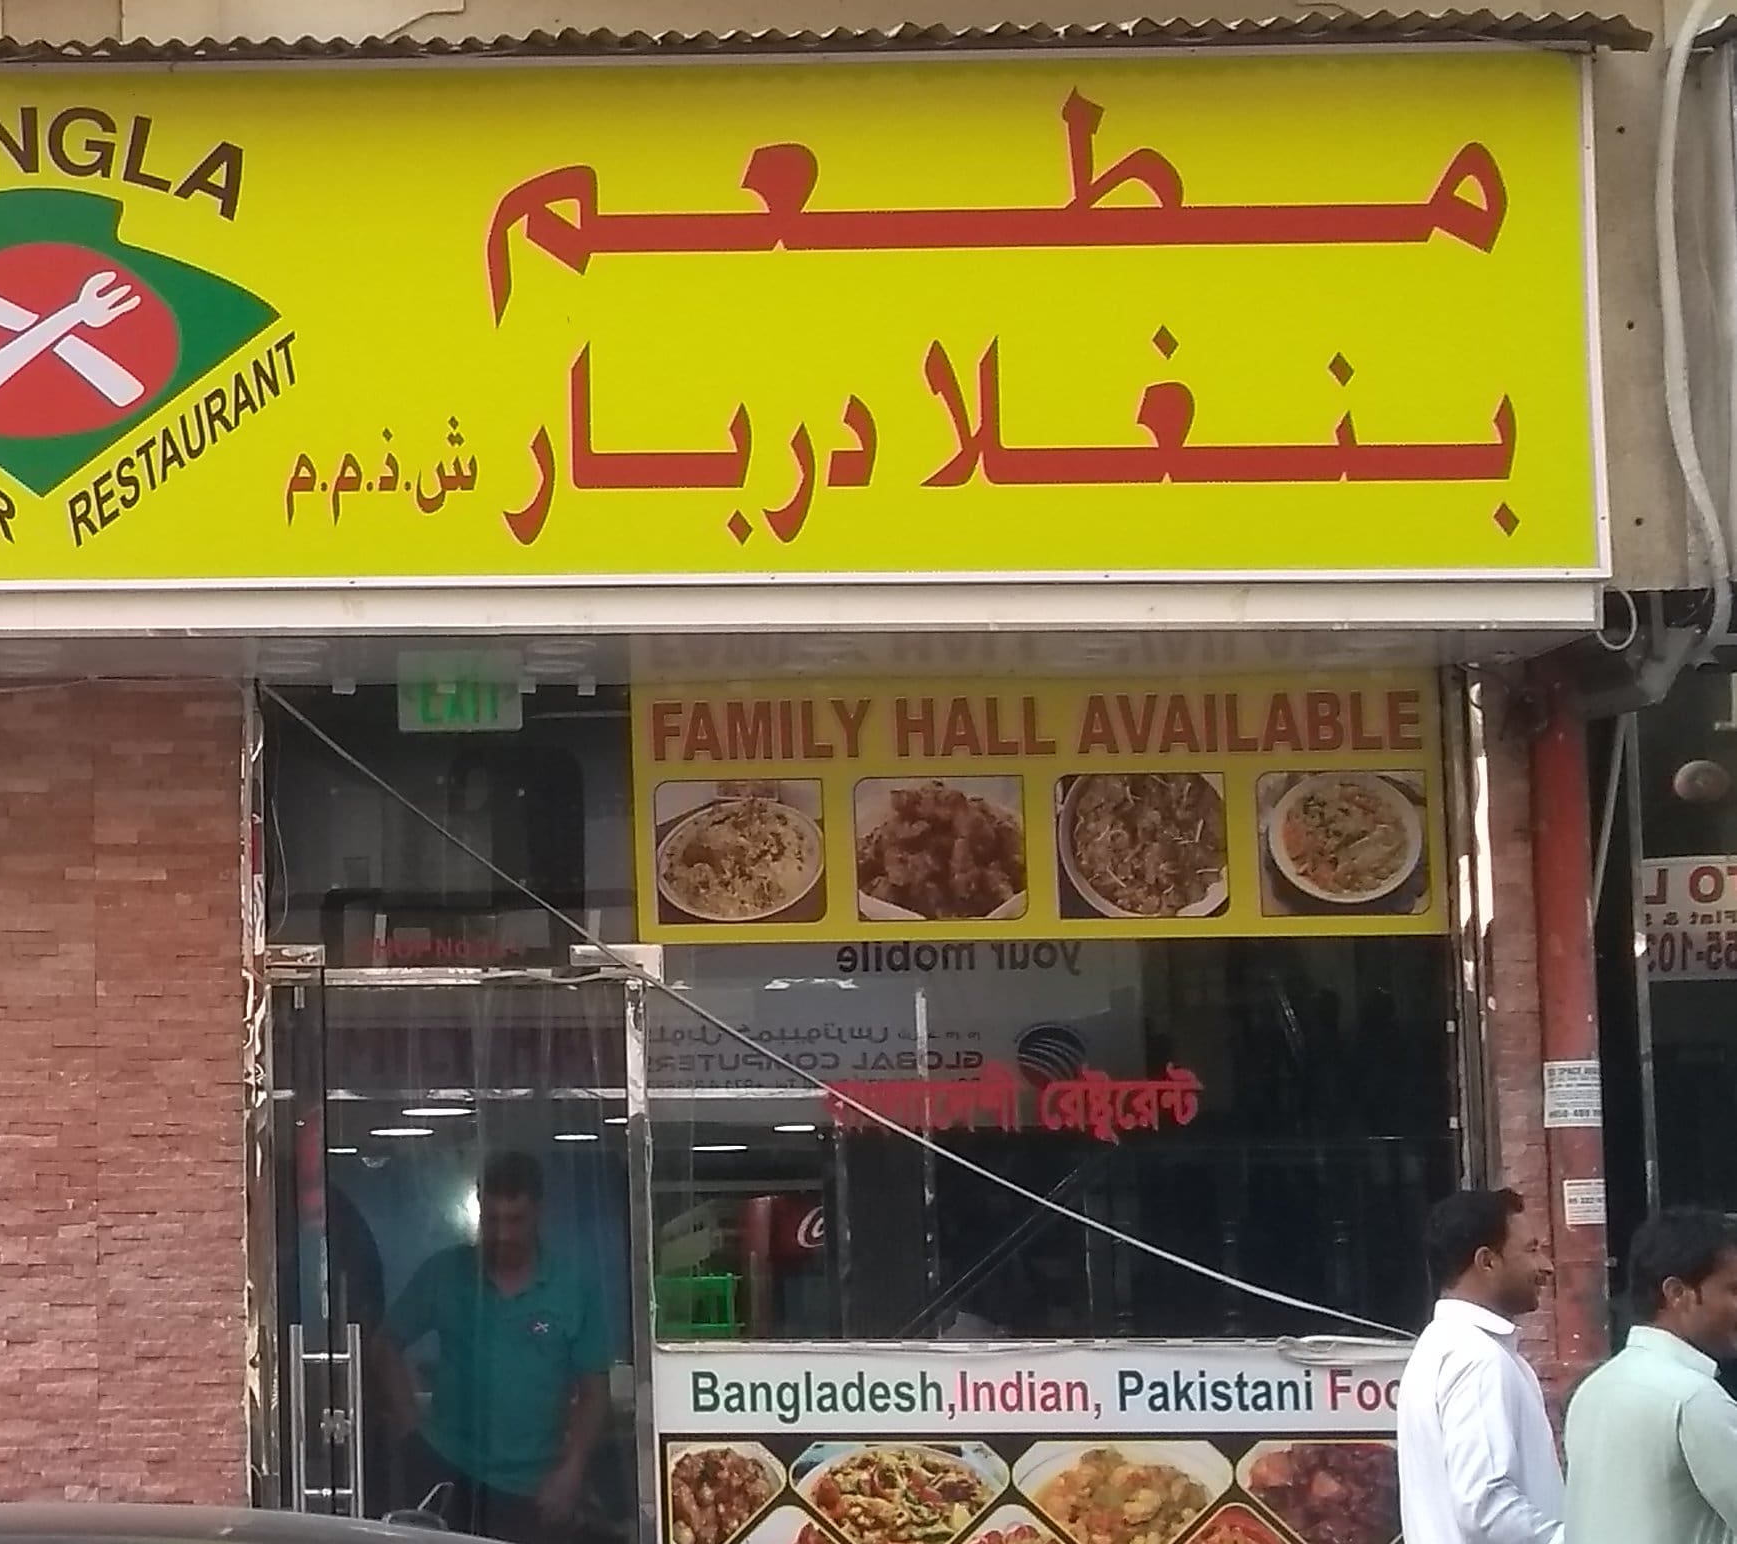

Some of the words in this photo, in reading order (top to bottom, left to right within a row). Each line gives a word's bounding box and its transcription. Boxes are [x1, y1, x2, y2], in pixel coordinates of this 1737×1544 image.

[486, 85, 1508, 328] مطعم
[67, 331, 297, 548] RESTAURANT
[502, 340, 878, 545] دربار
[920, 325, 1520, 537] بنغلا
[651, 697, 870, 763] FAMILY
[895, 695, 1057, 758] HALL
[1078, 690, 1423, 755] AVAILABLE
[1117, 1368, 1313, 1413] Pakistani
